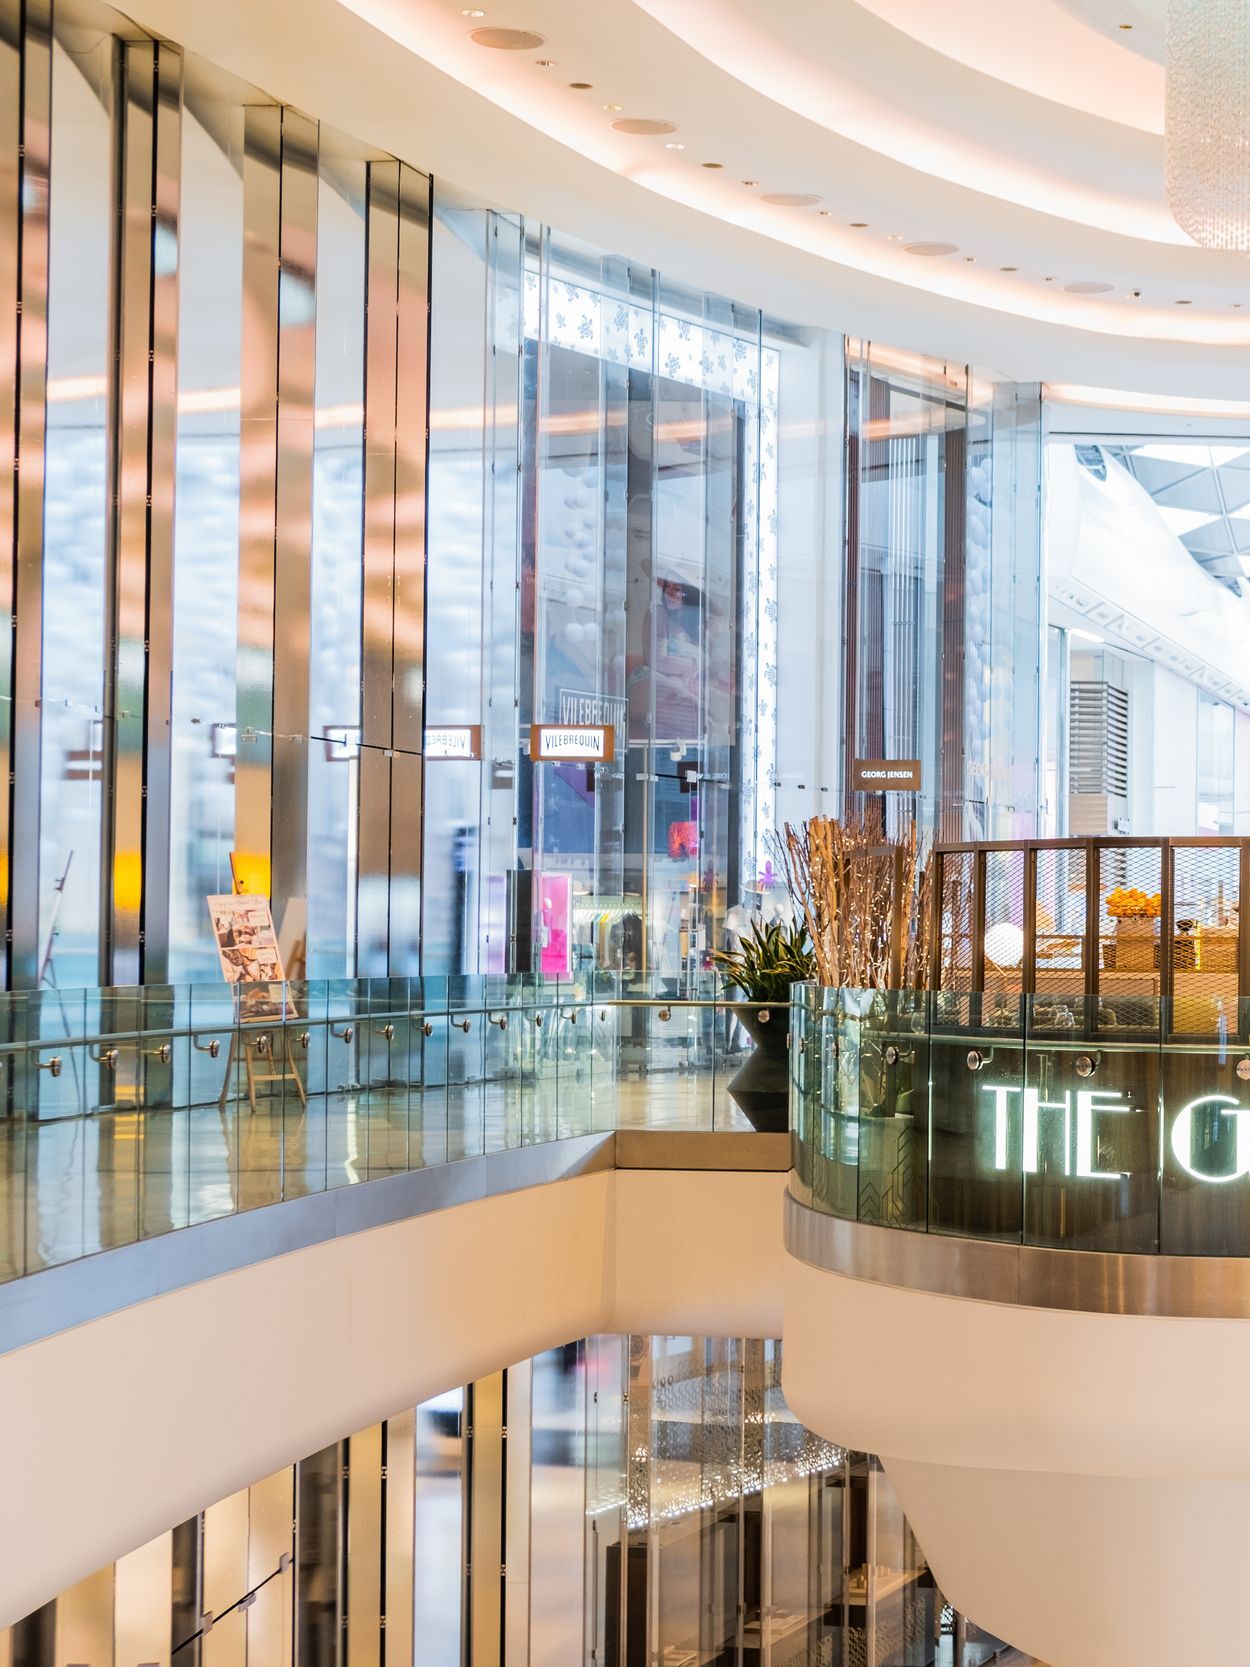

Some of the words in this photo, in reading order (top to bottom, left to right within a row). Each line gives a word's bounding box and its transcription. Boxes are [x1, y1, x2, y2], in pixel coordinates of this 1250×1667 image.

[545, 734, 600, 751] VILEBREQUIN
[861, 770, 886, 779] GEORG
[887, 770, 913, 779] JENSEN
[982, 1085, 1132, 1180] THE
